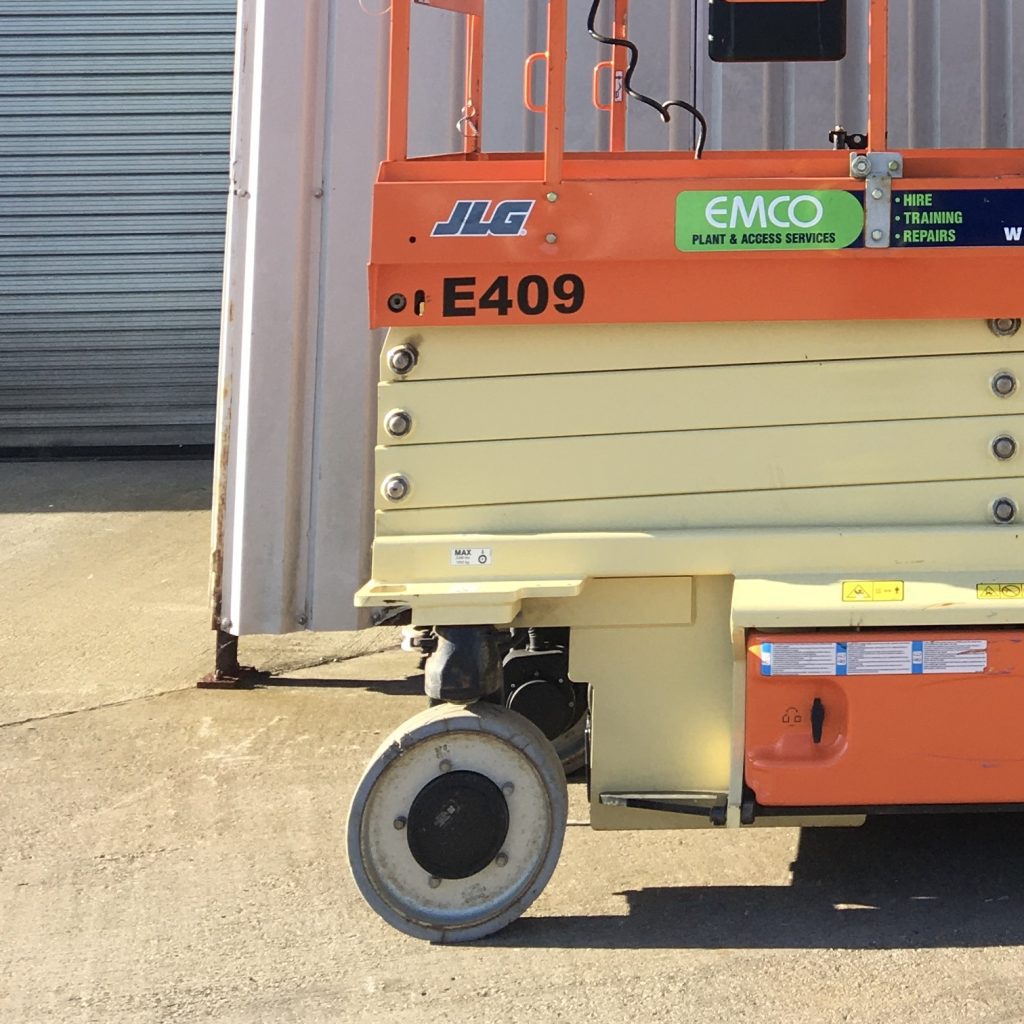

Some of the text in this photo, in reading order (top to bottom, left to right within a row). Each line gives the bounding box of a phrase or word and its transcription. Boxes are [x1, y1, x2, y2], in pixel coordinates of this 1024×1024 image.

[903, 193, 933, 207] HIRE
[430, 199, 535, 237] JLG
[704, 194, 824, 229] EMCO
[903, 210, 963, 225] TRAINING
[692, 231, 836, 245] PLANT & ACCESS SERVICES
[903, 228, 956, 243] REPAIRS
[443, 273, 585, 317] E409
